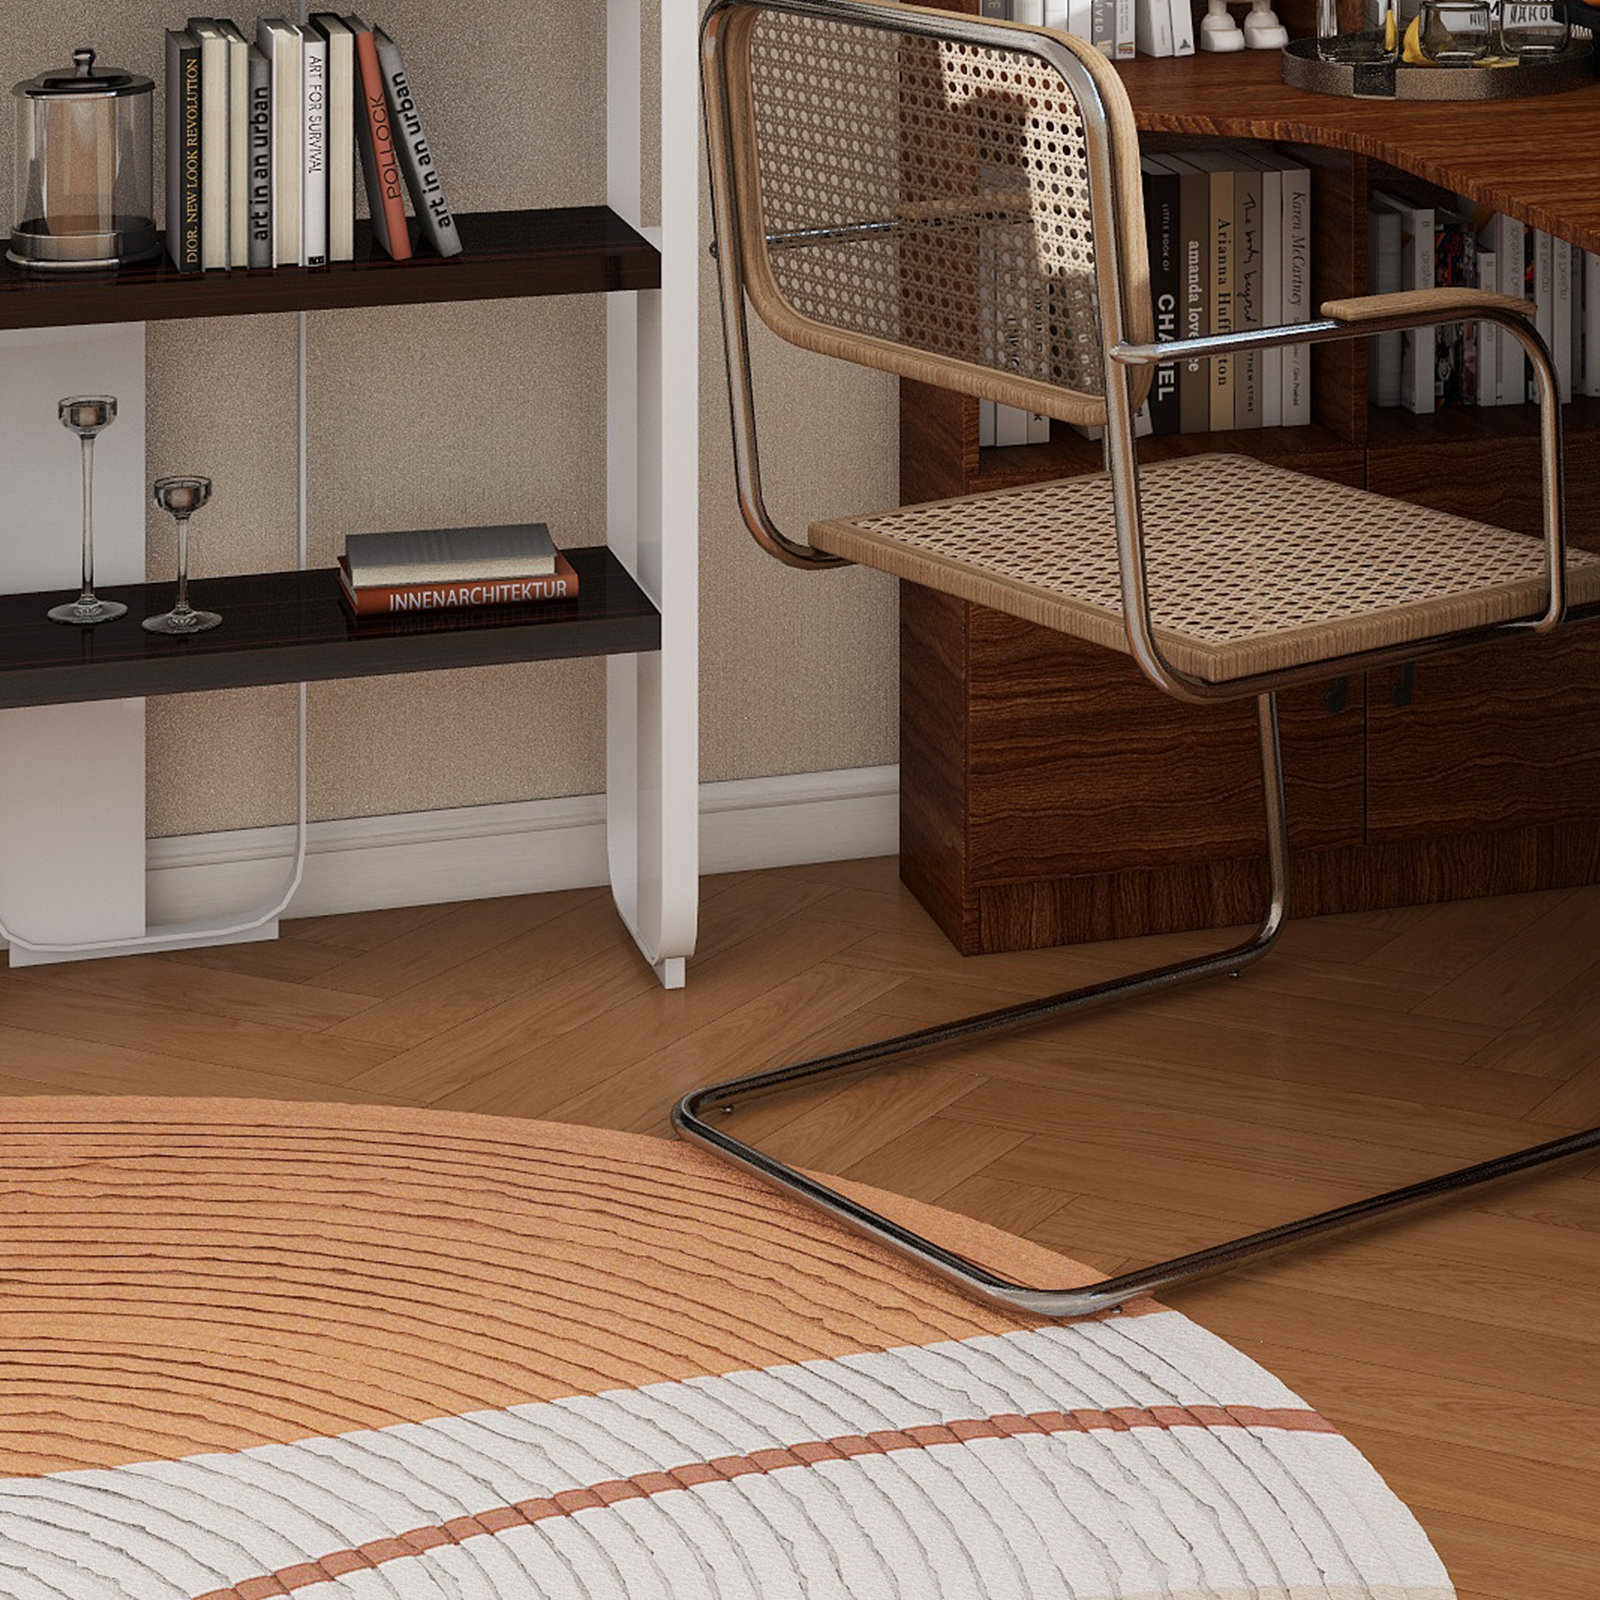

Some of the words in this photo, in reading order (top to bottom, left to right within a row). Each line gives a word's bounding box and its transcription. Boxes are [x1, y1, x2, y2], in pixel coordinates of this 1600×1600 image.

[308, 55, 322, 79] ART
[187, 58, 198, 147] REVOLUTION
[308, 84, 322, 111] FOR
[392, 72, 421, 135] urban
[250, 86, 268, 148] urban
[308, 115, 323, 174] SURVIVAL
[370, 93, 400, 199] POLLOCK
[413, 139, 431, 166] an
[187, 150, 198, 189] LOOK
[254, 154, 268, 179] an
[423, 171, 440, 193] in
[187, 192, 198, 223] NEW
[250, 186, 268, 205] in
[430, 196, 451, 228] art
[1242, 192, 1257, 225] The
[1292, 191, 1307, 230] Karen
[250, 211, 268, 241] art
[1162, 233, 1170, 255] BOOK
[187, 228, 198, 264] DIOR.
[1218, 218, 1232, 285] Arianna
[1243, 230, 1260, 264] body
[1188, 240, 1202, 302] amanda
[1288, 235, 1306, 306] McCartney
[1237, 270, 1258, 322] beyond
[1158, 294, 1175, 401] CHAEL
[1188, 307, 1203, 372] lovece
[1216, 292, 1232, 386] Huffton
[389, 580, 568, 611] INNENARCHITEKTUR
